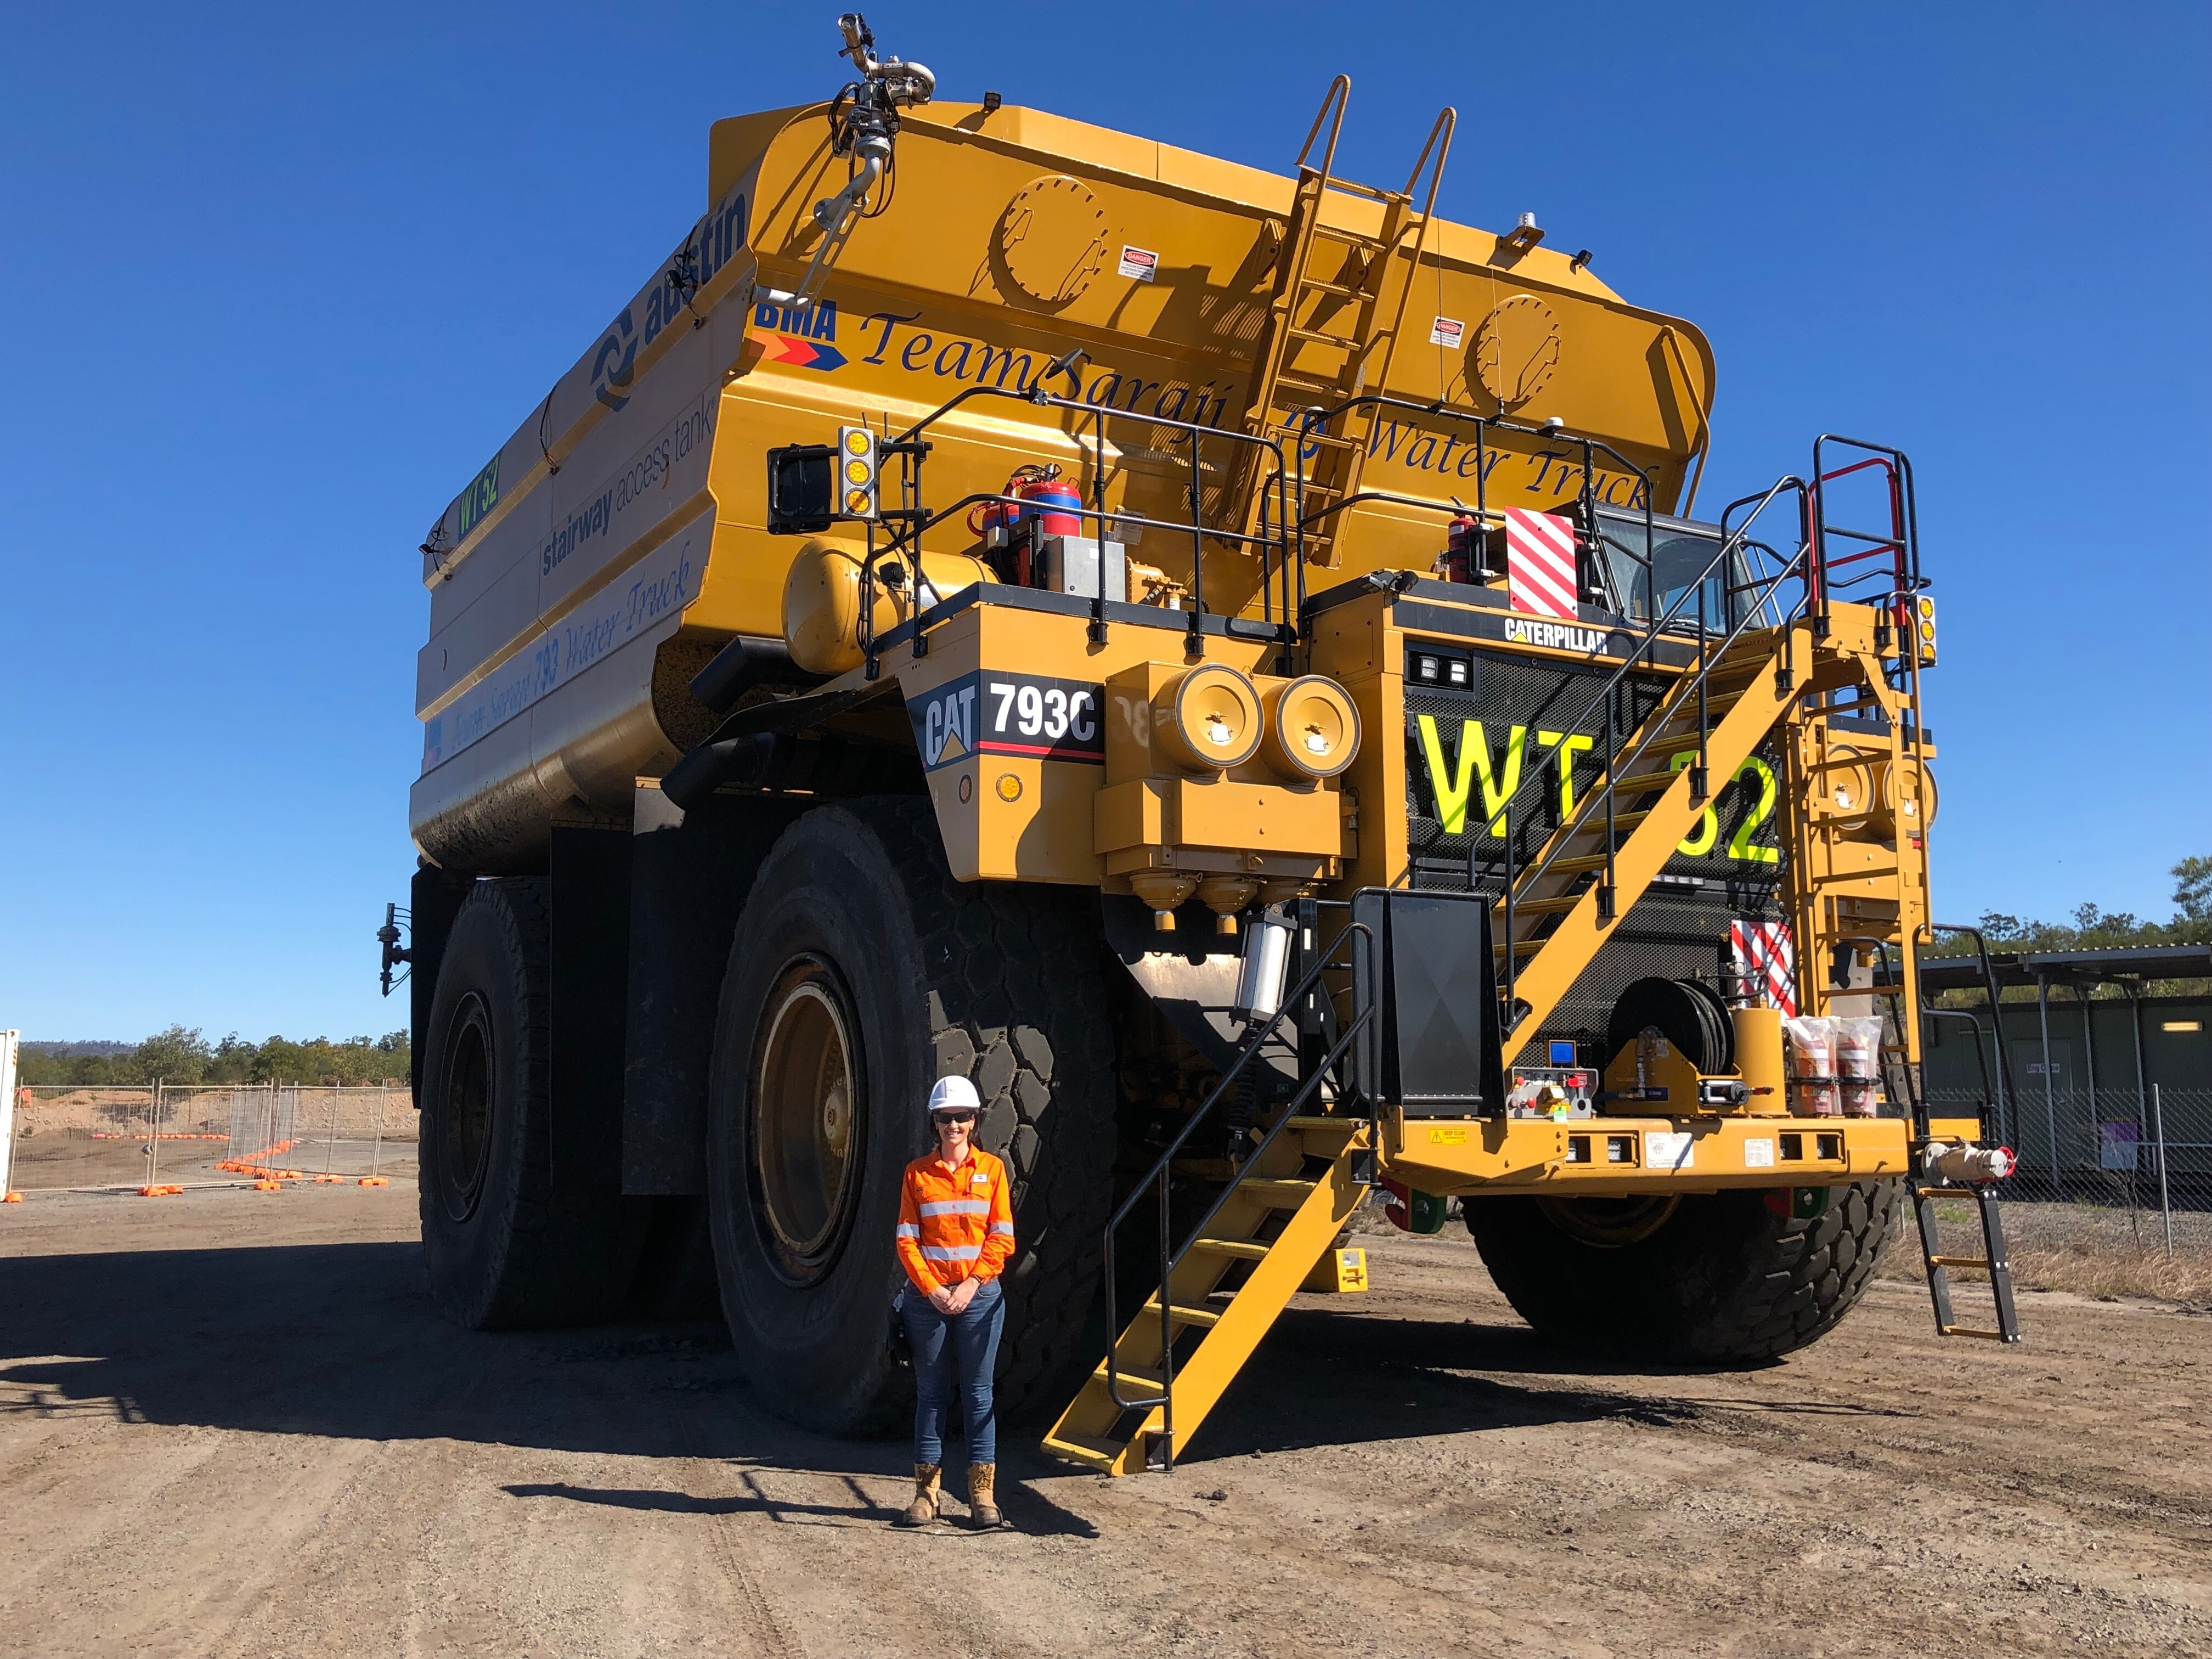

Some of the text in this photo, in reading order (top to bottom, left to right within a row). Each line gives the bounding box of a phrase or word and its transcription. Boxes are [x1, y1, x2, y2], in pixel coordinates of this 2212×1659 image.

[645, 193, 746, 346] austin
[1127, 253, 1152, 264] DANGER
[860, 311, 1038, 392] Team
[1051, 352, 1234, 444] Saraji
[1360, 404, 1511, 482] Water
[1525, 448, 1661, 511] Truck
[461, 456, 500, 535] WT 52
[543, 489, 613, 576] stairway
[617, 438, 670, 512] access
[566, 610, 620, 673] Water
[626, 539, 691, 633] Truck
[1504, 618, 1607, 655] CATERPILLAR
[925, 685, 975, 766] CAT
[990, 682, 1095, 742] 793C
[1417, 713, 1594, 838] WT
